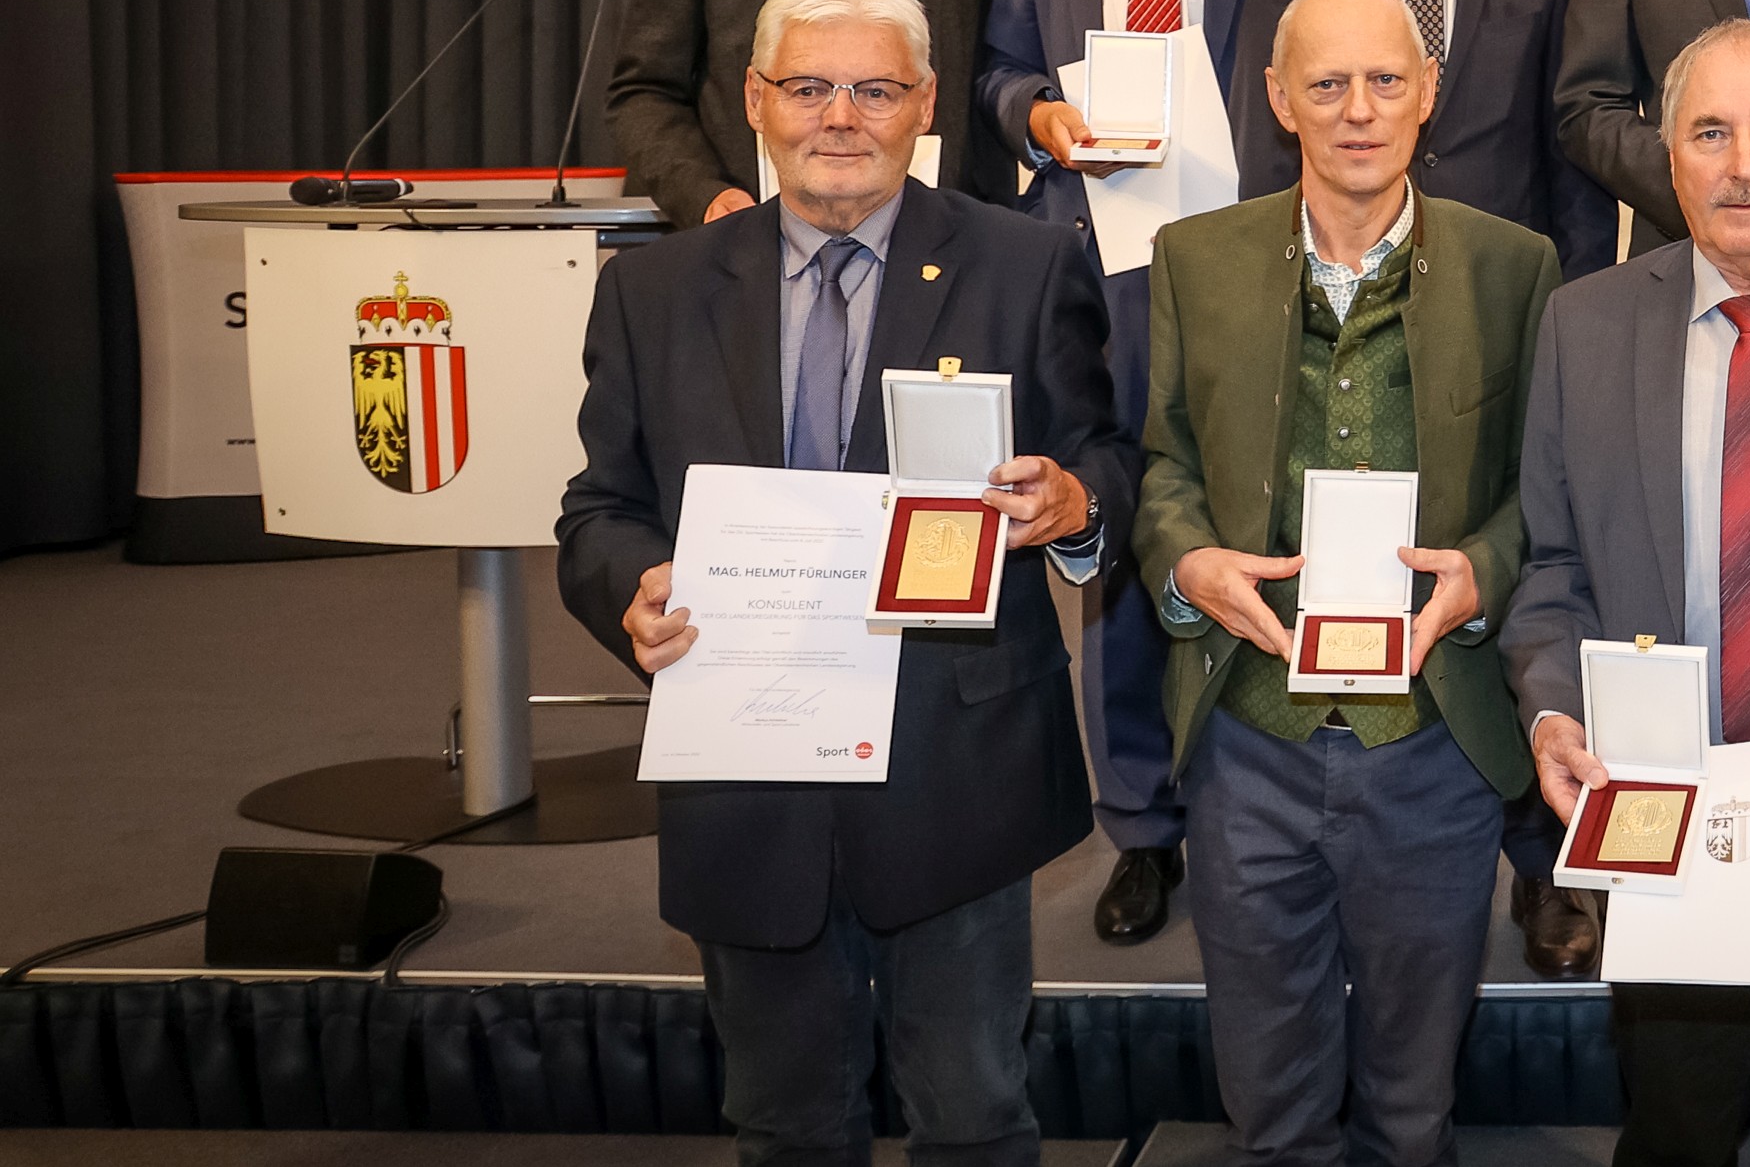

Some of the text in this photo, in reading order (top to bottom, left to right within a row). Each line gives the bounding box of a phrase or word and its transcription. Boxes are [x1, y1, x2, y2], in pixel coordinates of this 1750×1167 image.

[708, 566, 867, 580] MAG. HELMUT FÜRLINGER
[747, 599, 823, 611] KONSULENT
[816, 746, 849, 759] Sport
